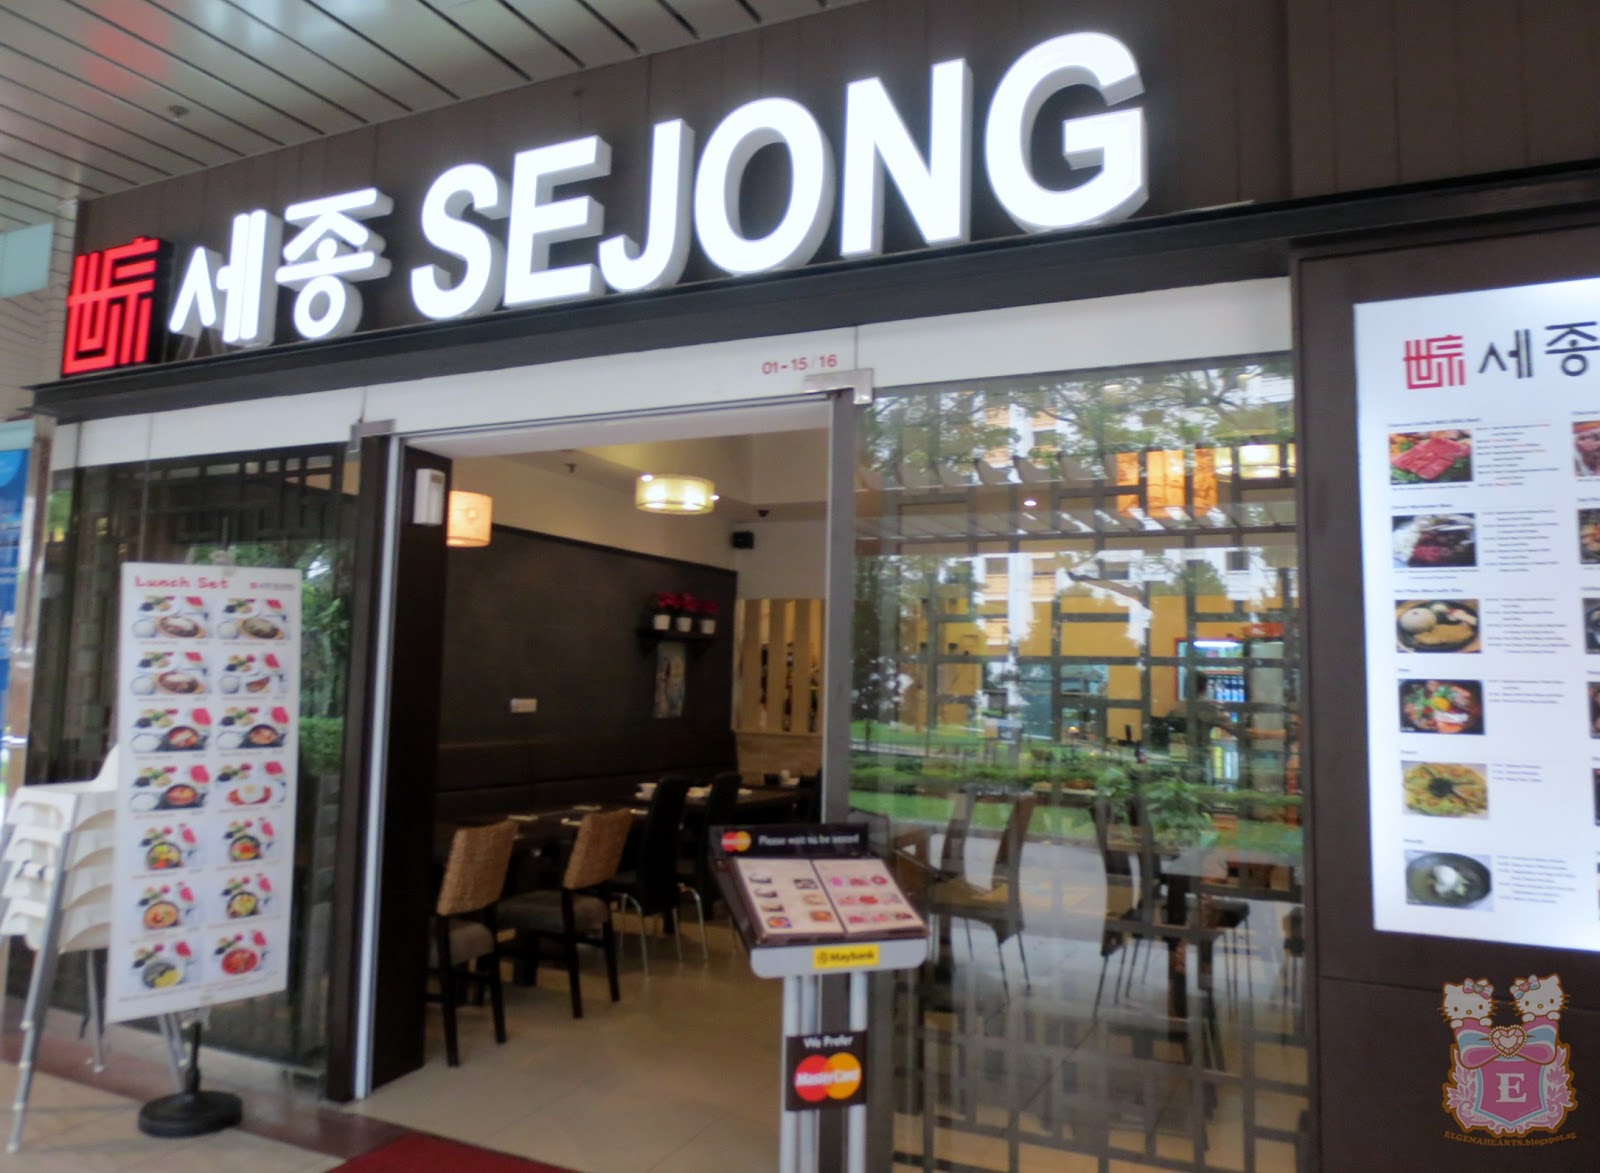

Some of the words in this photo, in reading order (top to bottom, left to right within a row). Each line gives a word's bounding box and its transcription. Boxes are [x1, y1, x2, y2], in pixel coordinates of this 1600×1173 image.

[168, 187, 392, 346] 세종
[411, 31, 1148, 321] SEJONG
[1478, 320, 1600, 380] 세종
[134, 575, 191, 588] Lunch
[198, 576, 229, 589] Set
[830, 949, 874, 963] Maybank
[803, 1036, 822, 1049] We
[823, 1034, 854, 1047] Prefer
[796, 1069, 861, 1087] MasterCard
